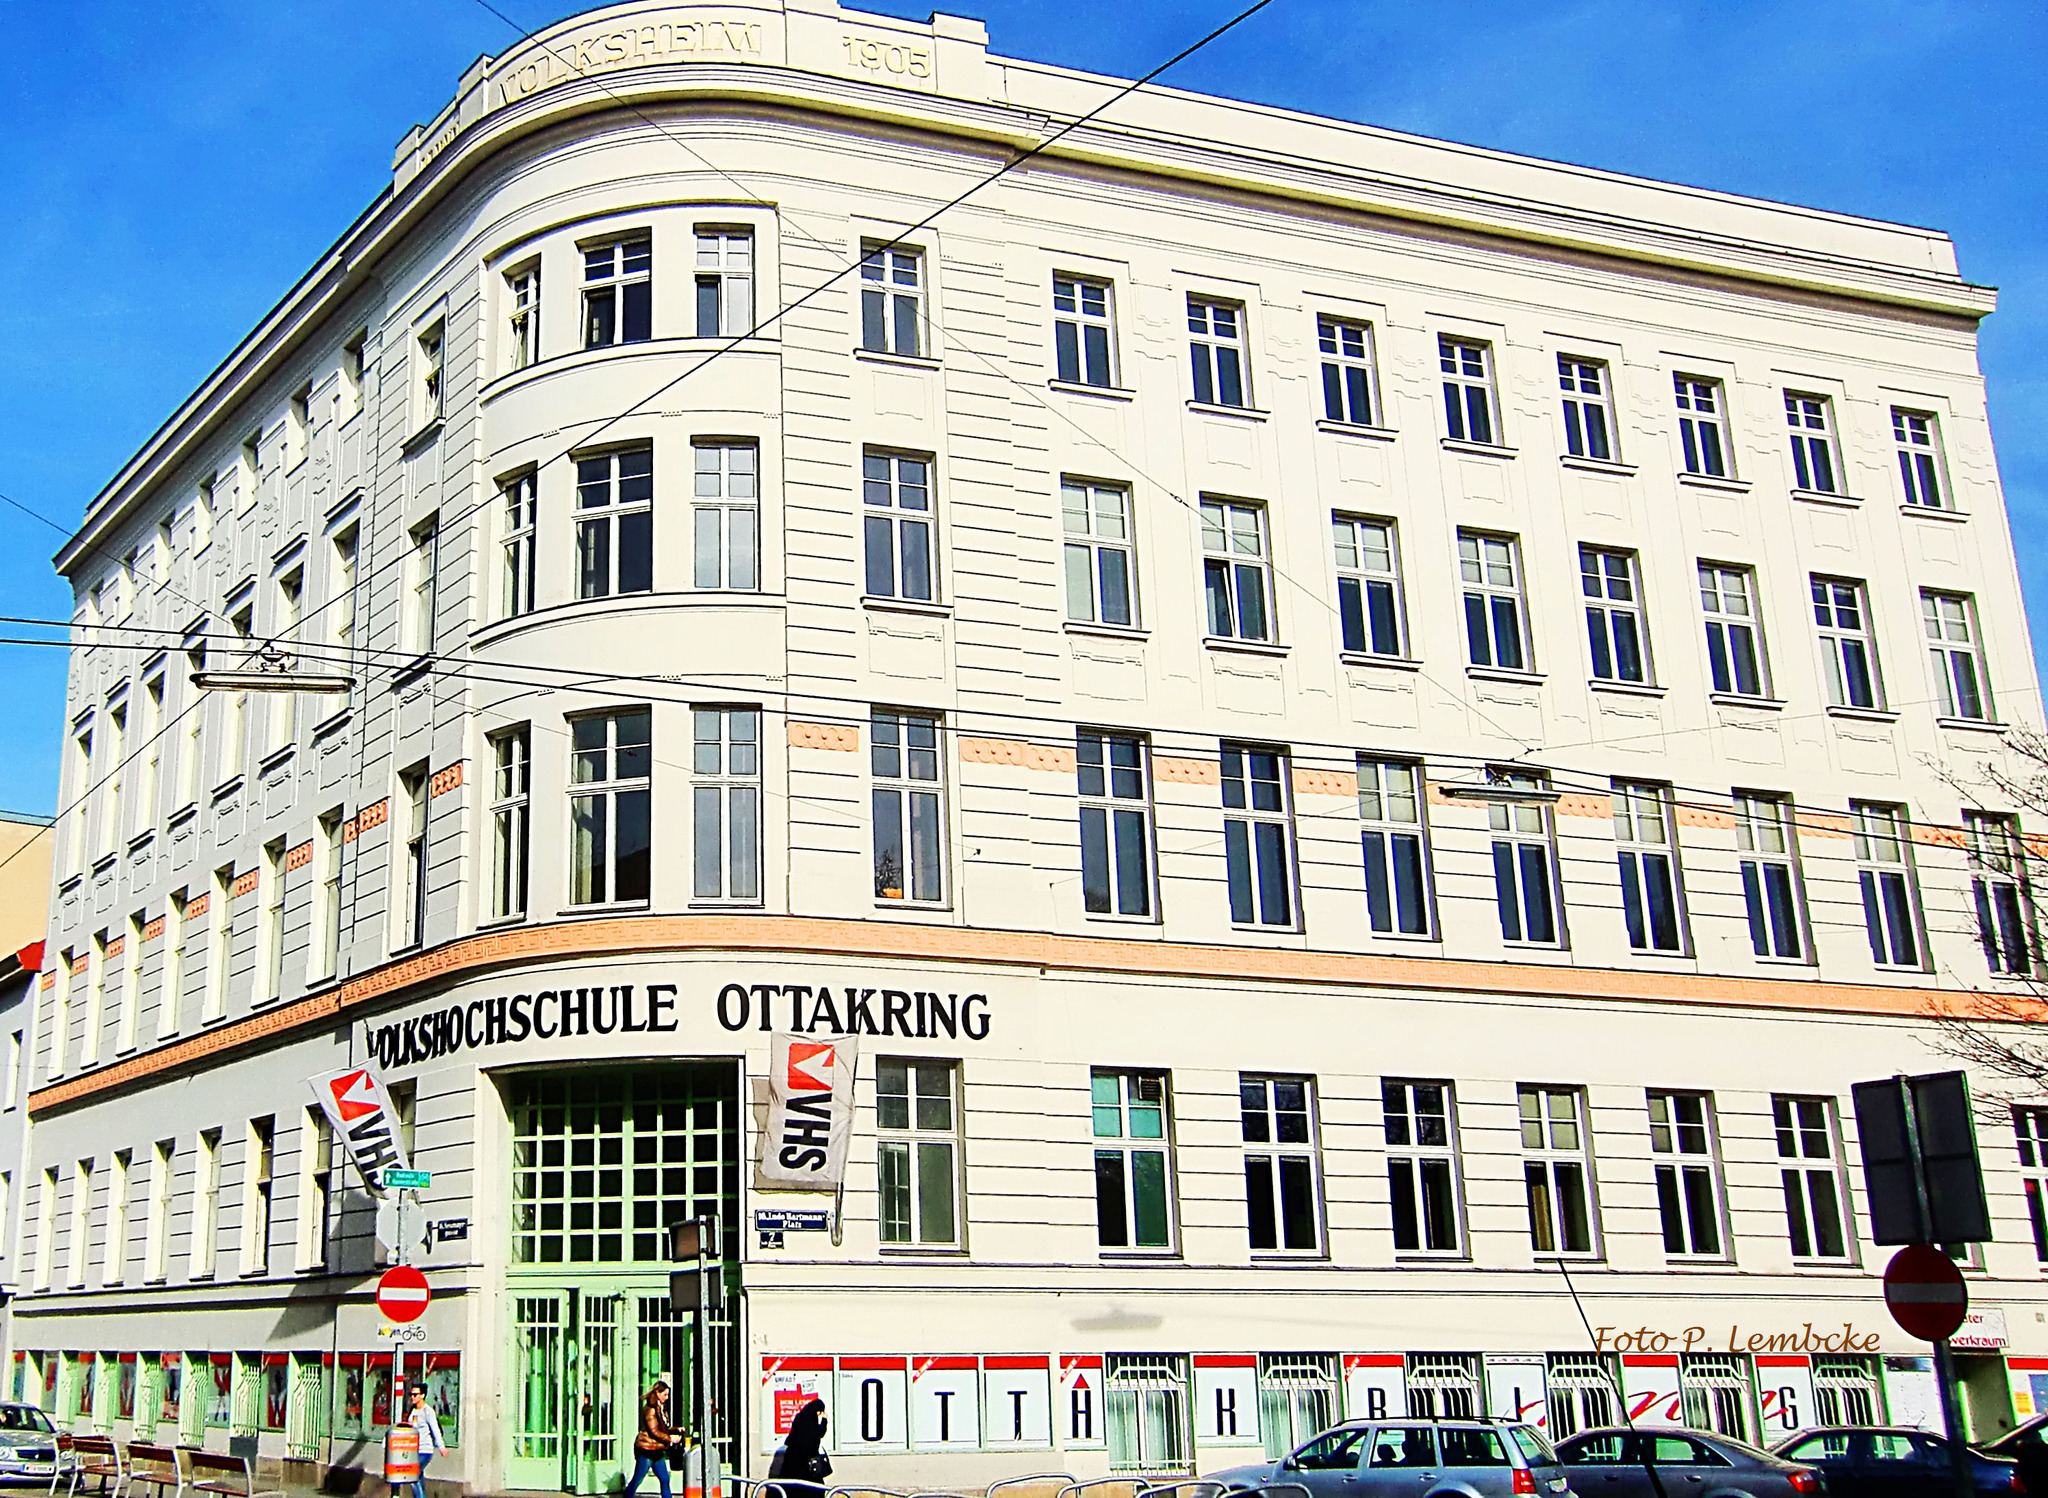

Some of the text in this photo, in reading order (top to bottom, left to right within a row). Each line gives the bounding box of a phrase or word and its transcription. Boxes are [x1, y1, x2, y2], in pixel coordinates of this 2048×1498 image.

[500, 21, 761, 105] VOLKSHEIM
[842, 35, 931, 78] 1905
[366, 983, 991, 1071] VOLKSHOCHSCHULE OTTAKRING
[778, 1093, 832, 1172] VHS
